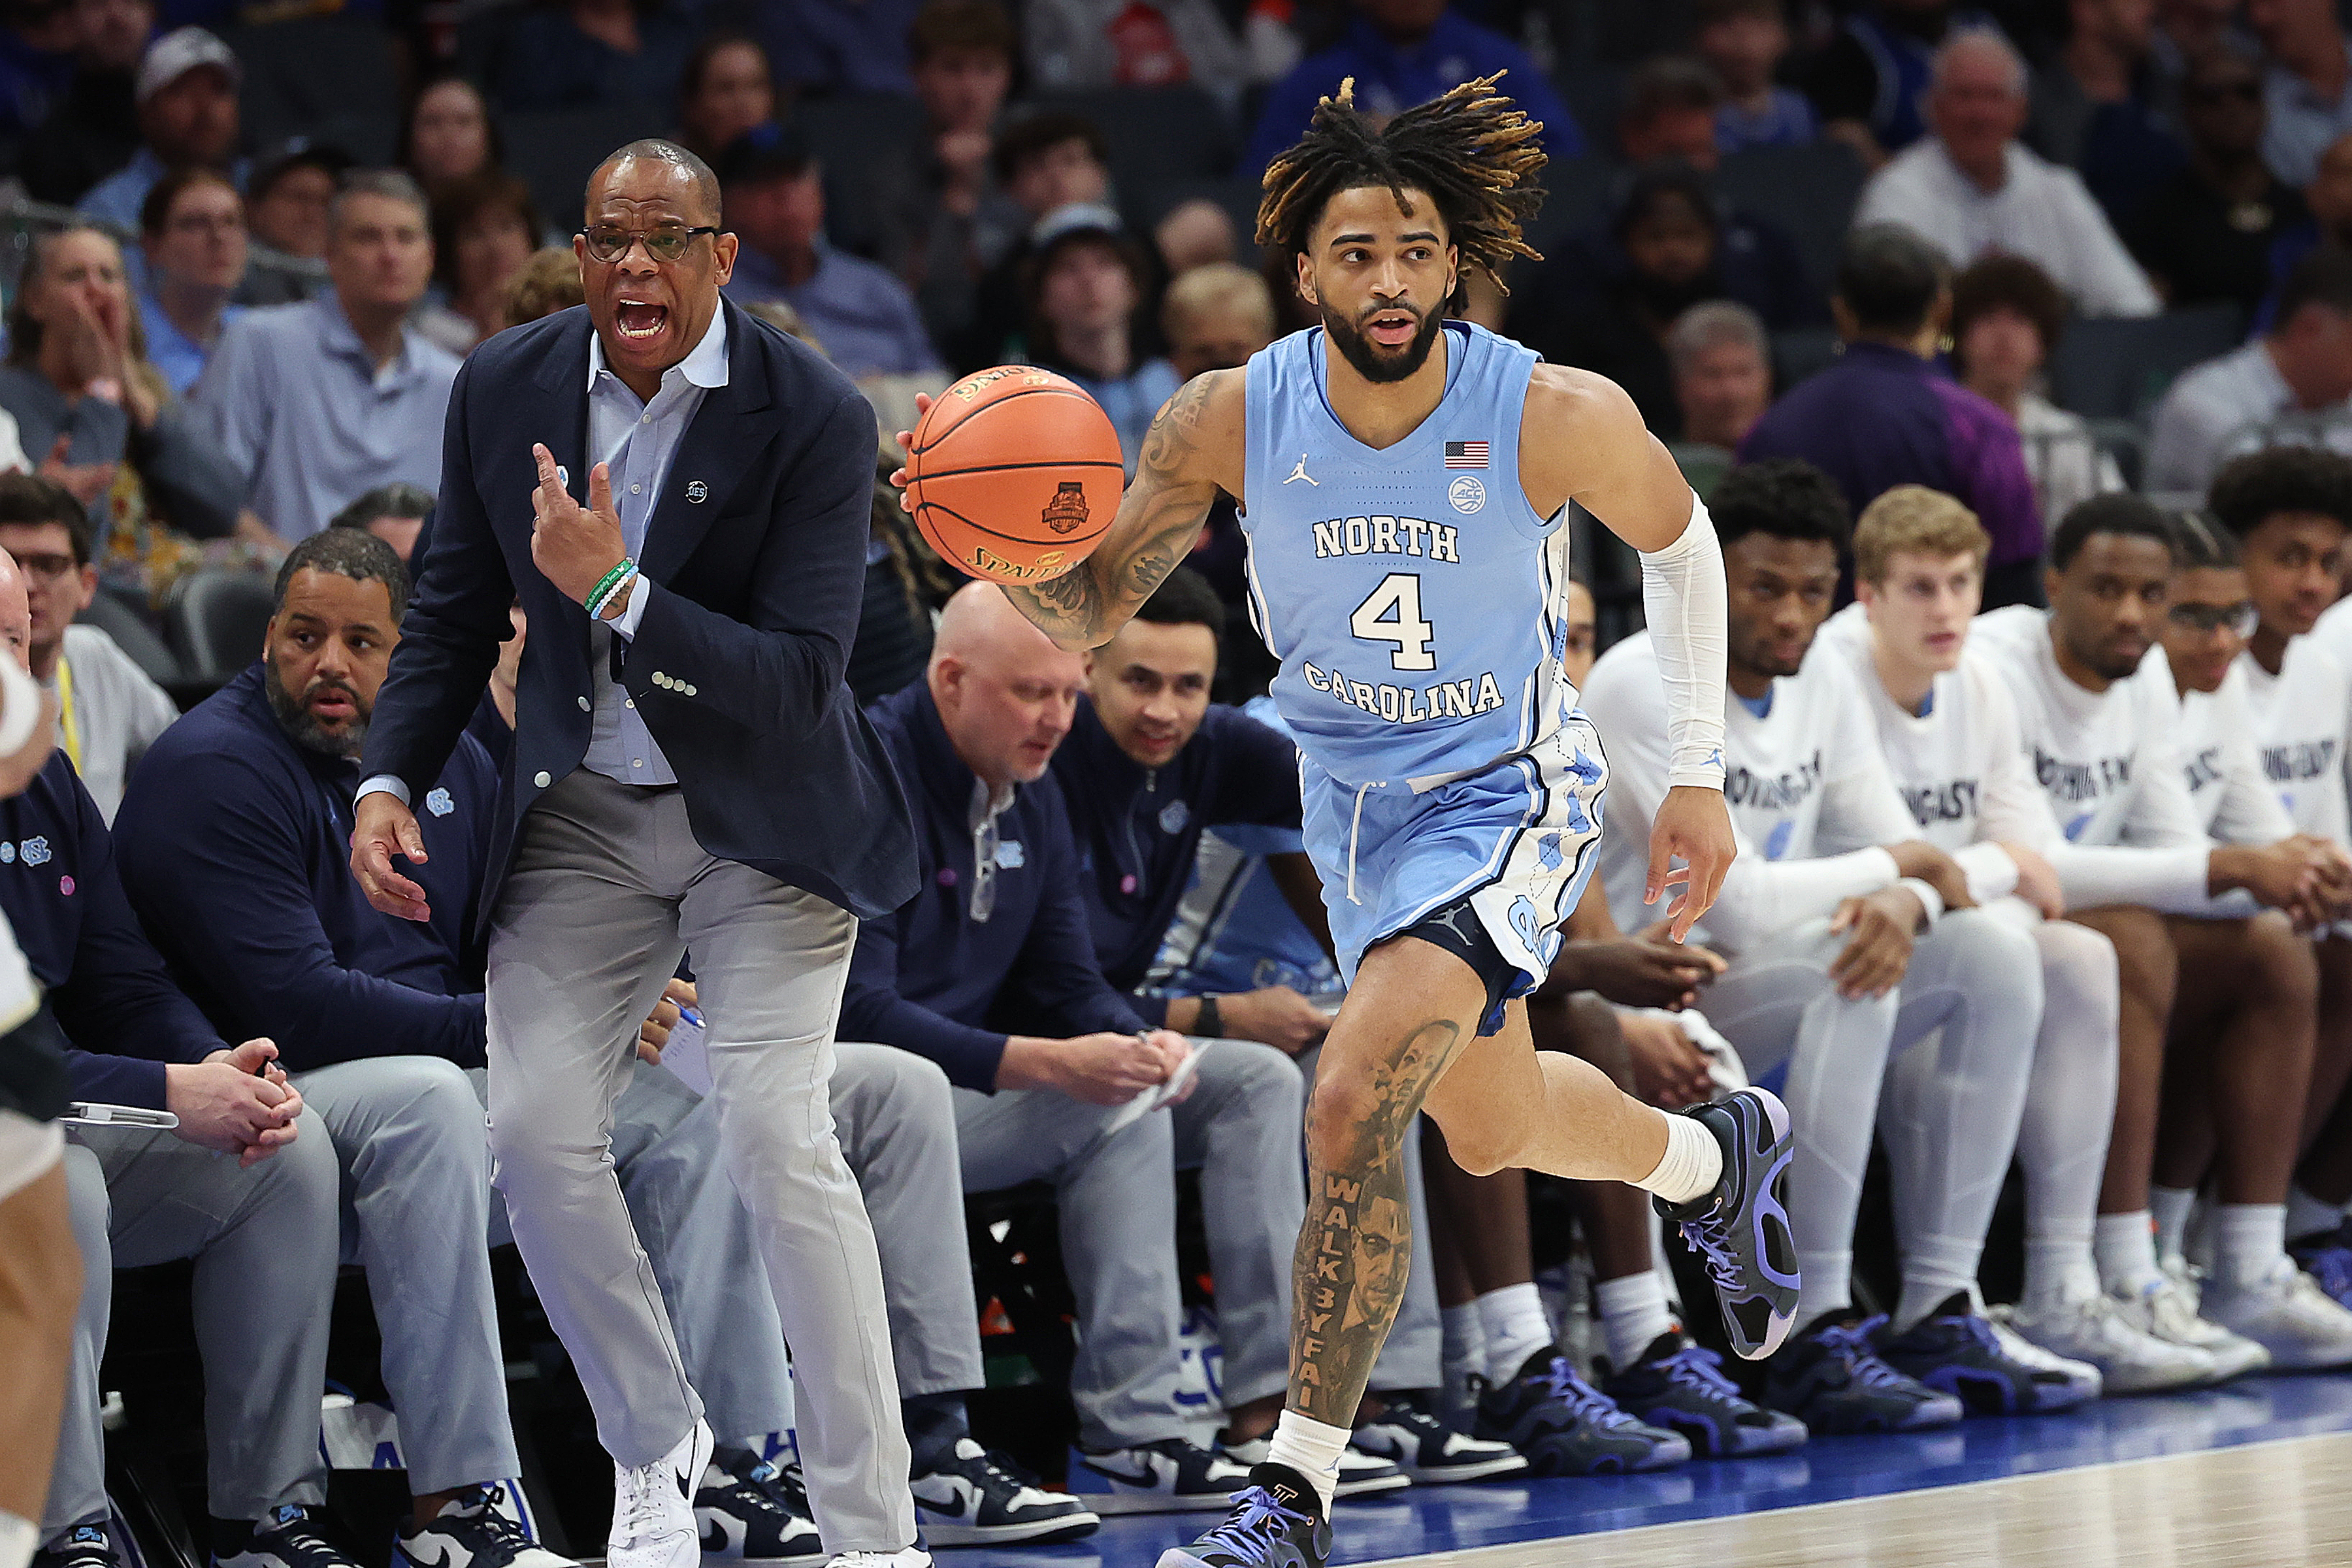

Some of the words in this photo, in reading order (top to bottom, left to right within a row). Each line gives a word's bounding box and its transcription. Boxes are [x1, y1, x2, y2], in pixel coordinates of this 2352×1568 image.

[1313, 515, 1460, 564] NORTH
[1350, 572, 1437, 671] 4
[1303, 661, 1505, 725] CAROLINA
[1316, 1173, 1361, 1282] WALK
[1310, 1286, 1335, 1333] BY
[1292, 1336, 1325, 1418] FAI
